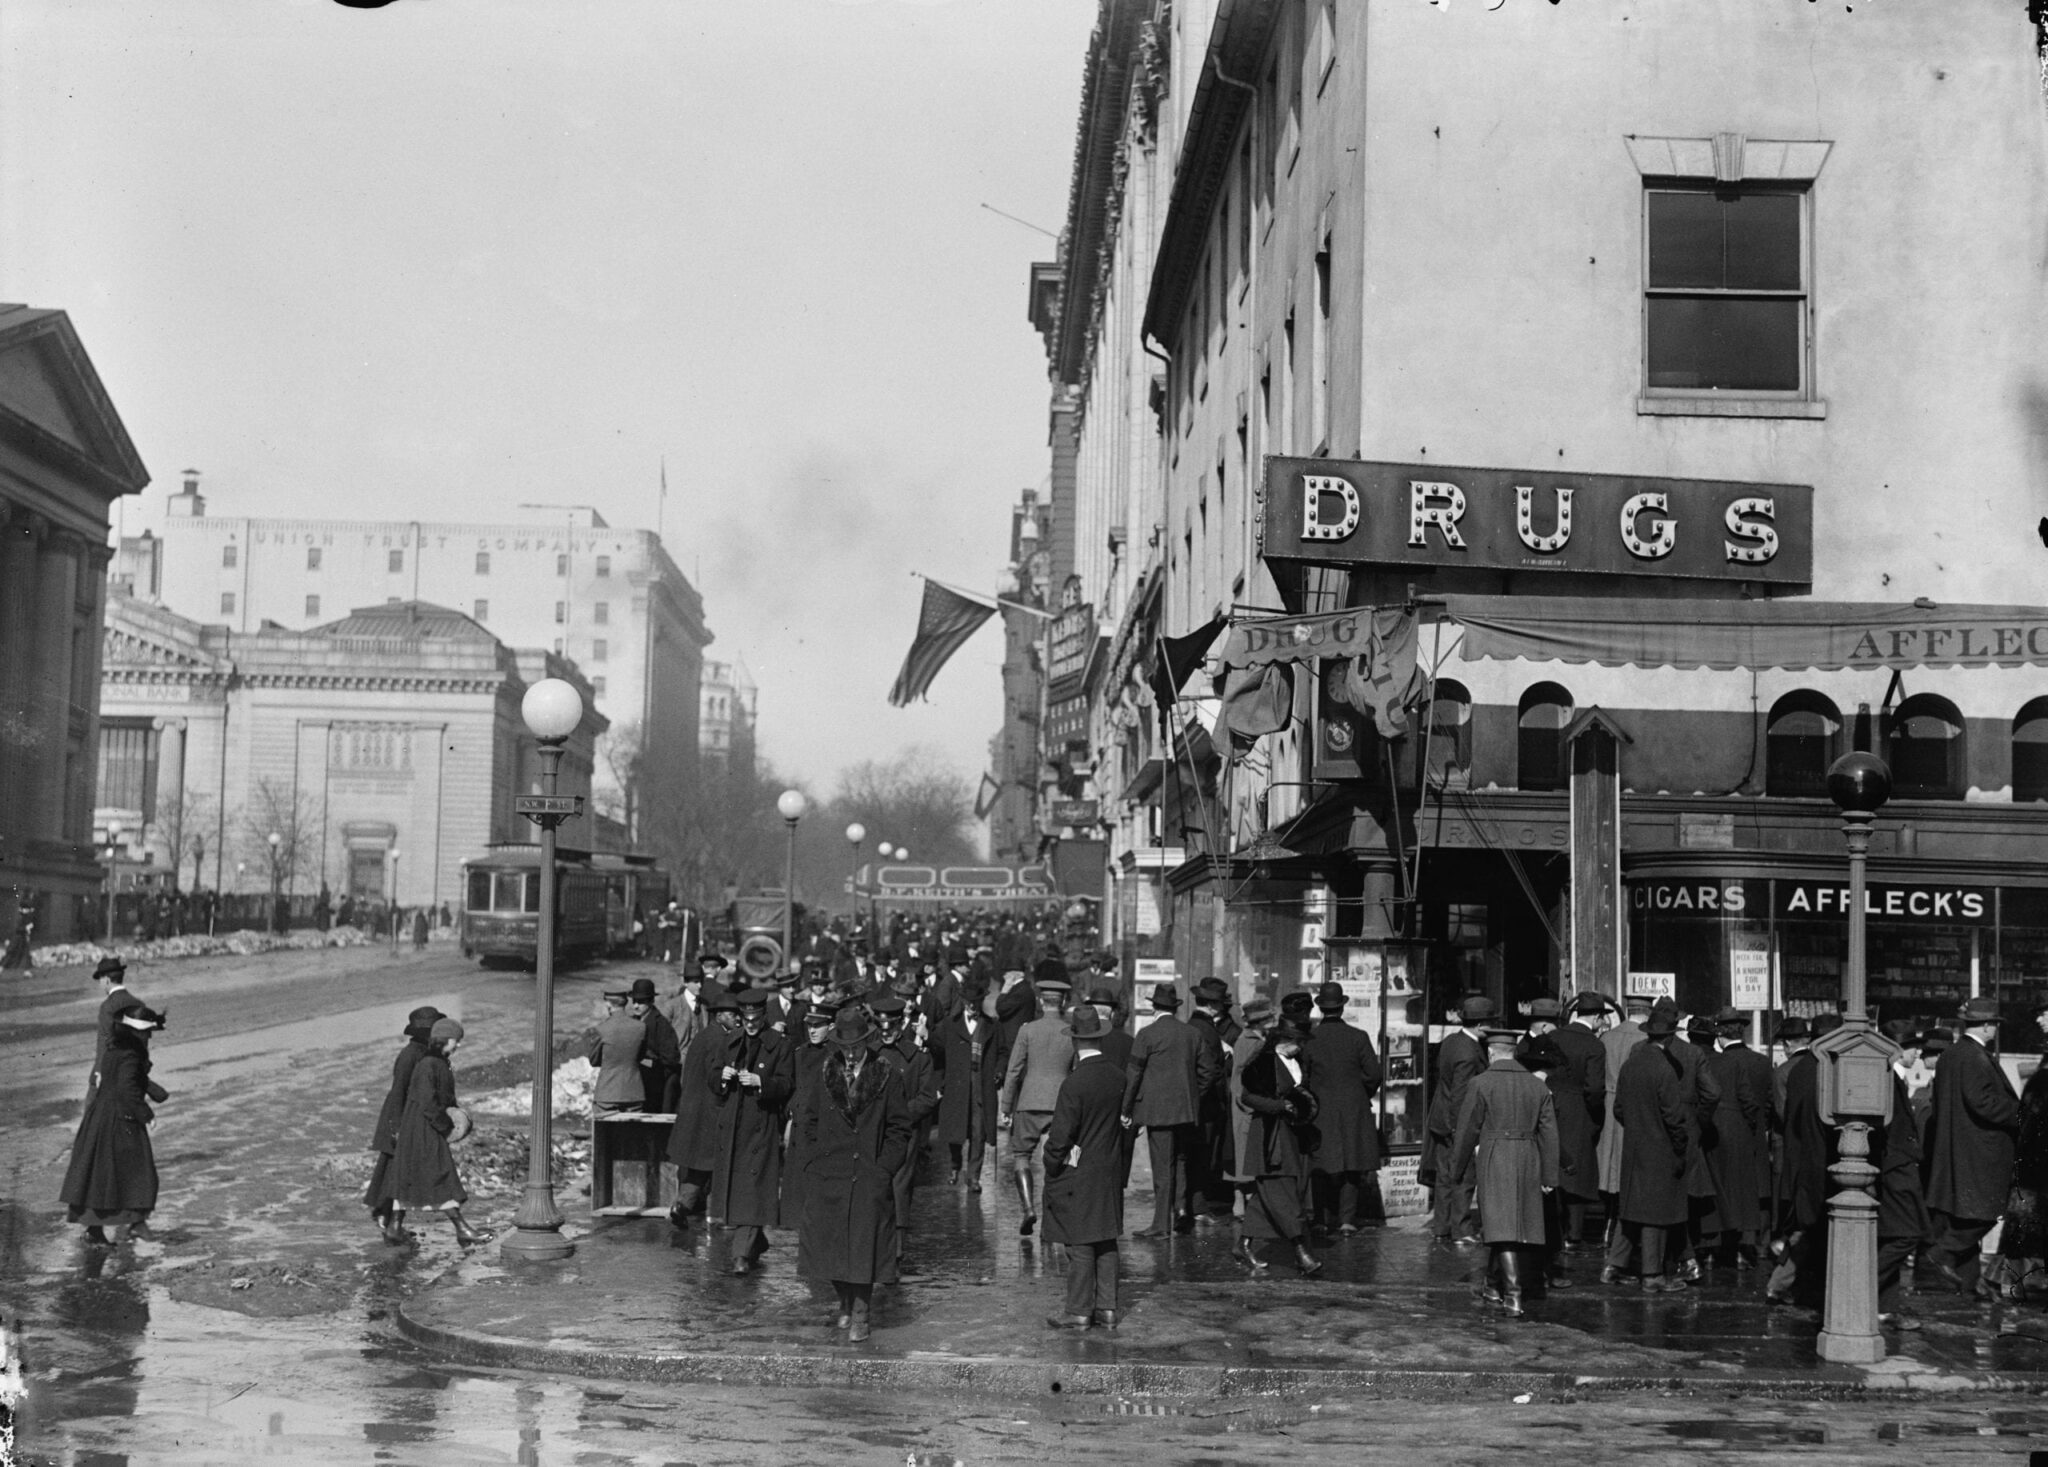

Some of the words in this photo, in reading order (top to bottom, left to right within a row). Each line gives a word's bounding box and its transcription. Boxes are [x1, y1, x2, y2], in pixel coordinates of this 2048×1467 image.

[1300, 474, 1779, 564] DRUGS
[255, 532, 334, 547] UNION
[364, 534, 448, 549] TRUST
[477, 537, 597, 552] COMPANY
[1848, 626, 2048, 659] AFFLEC
[146, 686, 183, 700] BANK
[1634, 886, 1746, 911] CIGARS
[1787, 887, 1984, 917] AFFLECK'S
[1632, 976, 1669, 994] LOEW'S
[1745, 984, 1762, 992] DAY
